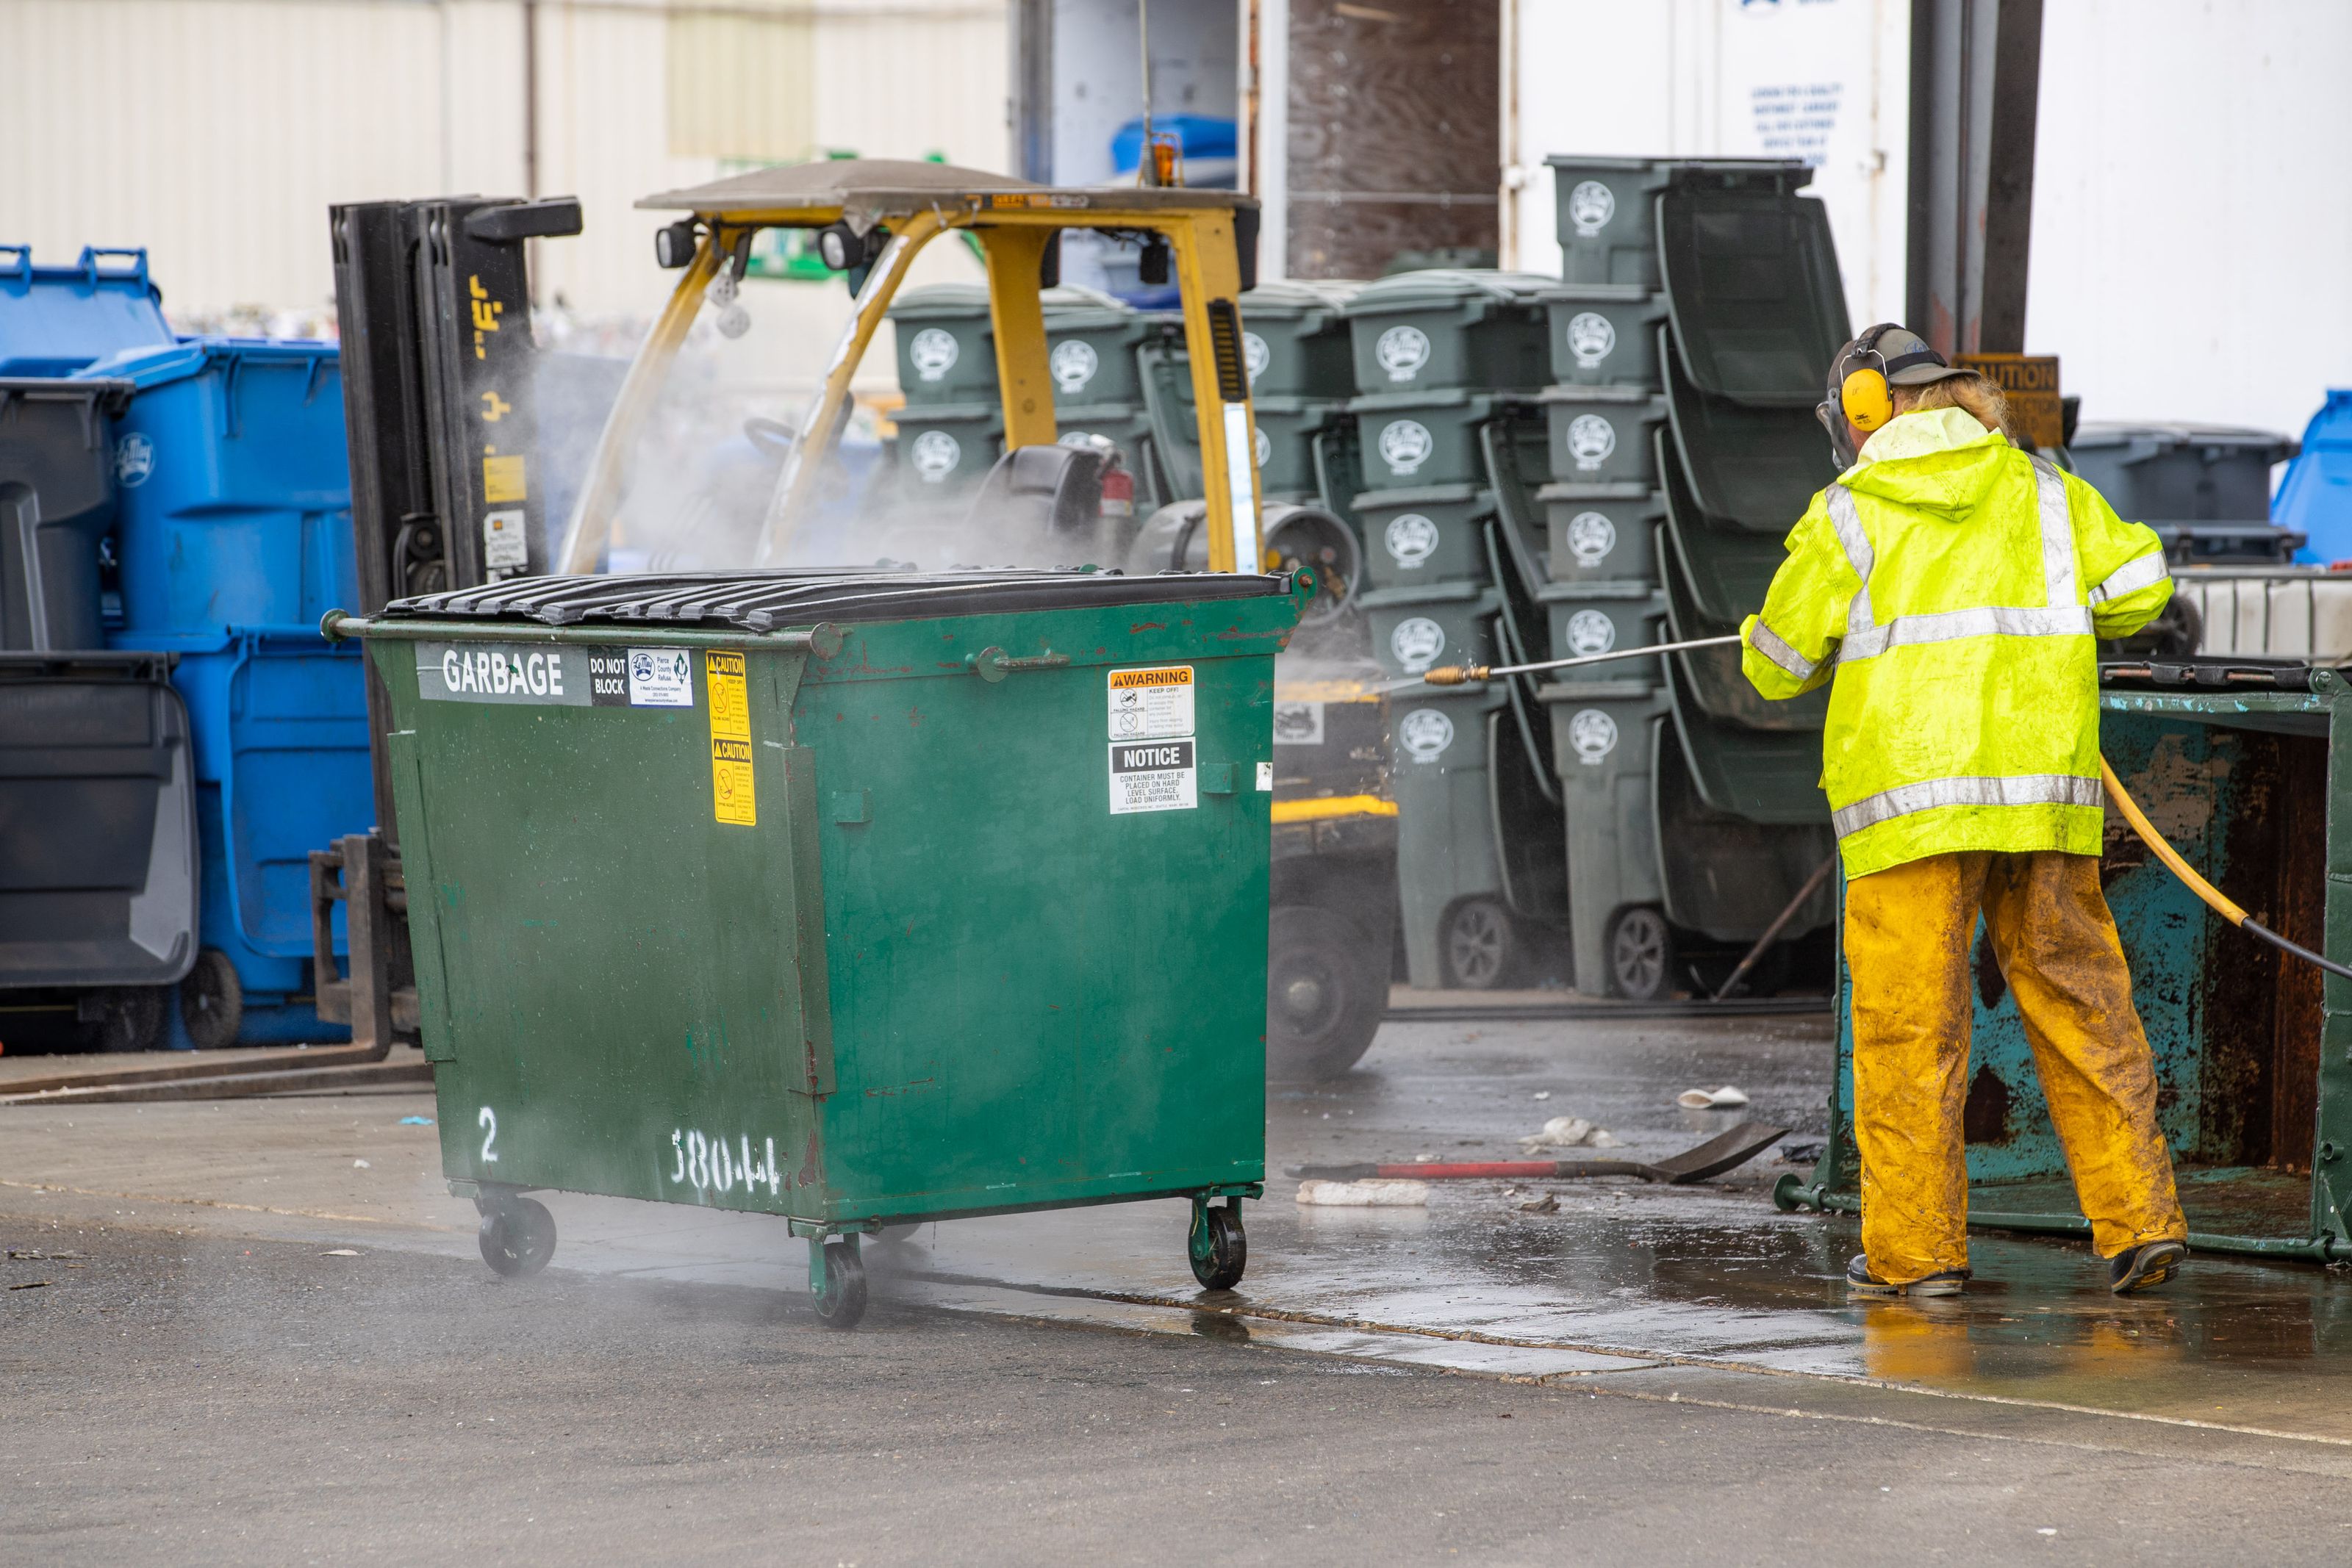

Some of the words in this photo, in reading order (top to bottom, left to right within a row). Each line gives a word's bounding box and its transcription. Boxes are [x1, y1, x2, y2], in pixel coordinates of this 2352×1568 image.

[590, 658, 605, 674] DO
[606, 658, 625, 675] NOT
[656, 656, 670, 664] Pierce
[716, 656, 743, 674] CAUTION
[443, 650, 563, 696] GARBAGE
[657, 666, 672, 674] County
[595, 678, 625, 694] BLOCK
[1123, 671, 1188, 686] WARNING
[722, 741, 750, 760] CAUTION
[1124, 747, 1180, 768] NOTICE
[1120, 774, 1155, 783] CONTAINER
[1144, 794, 1181, 802] UNIFORMLY.
[1148, 787, 1179, 795] SURFACE.
[478, 1107, 498, 1162] 2
